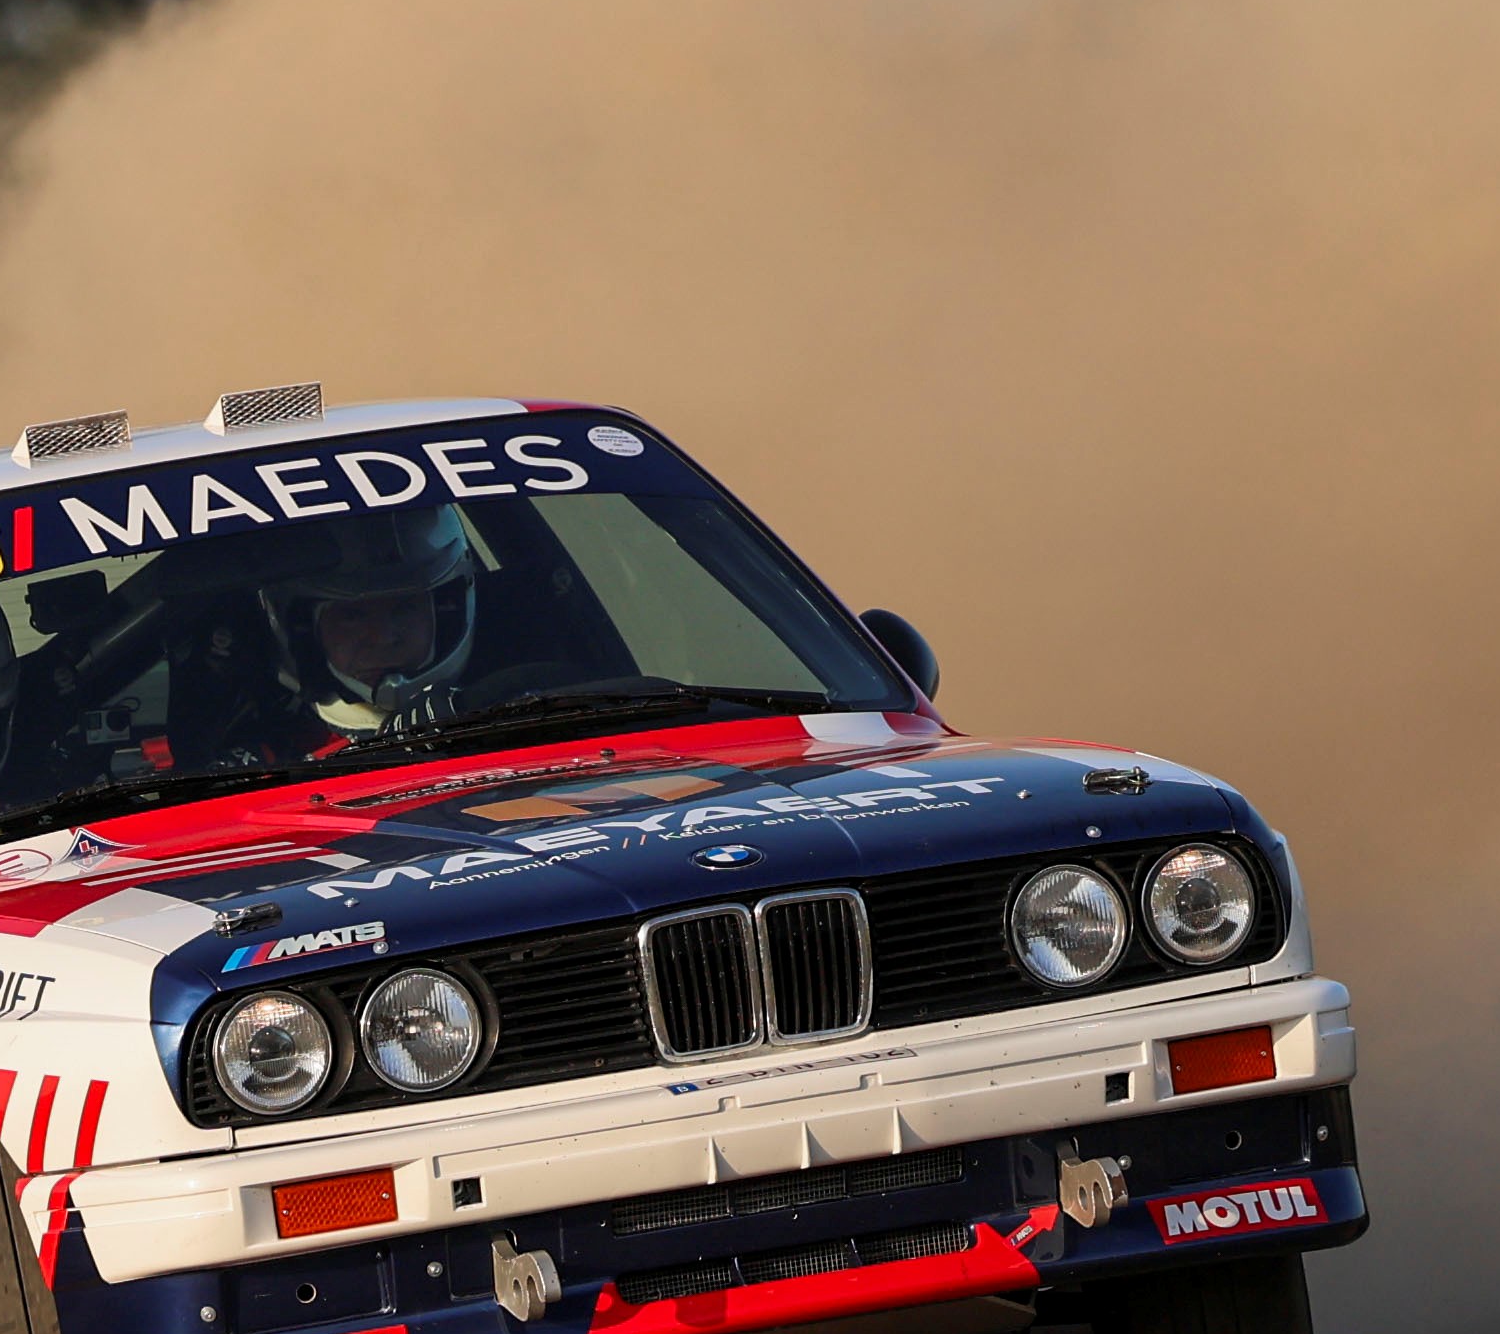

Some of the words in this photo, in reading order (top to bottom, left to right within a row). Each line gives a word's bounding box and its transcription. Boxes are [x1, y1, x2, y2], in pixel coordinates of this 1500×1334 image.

[59, 435, 590, 554] MAEDES
[307, 777, 1005, 899] MAEYAERT
[429, 845, 610, 889] Aannemingen
[762, 816, 795, 827] en
[267, 920, 386, 960] MATS
[1163, 1185, 1318, 1236] MOTUL
